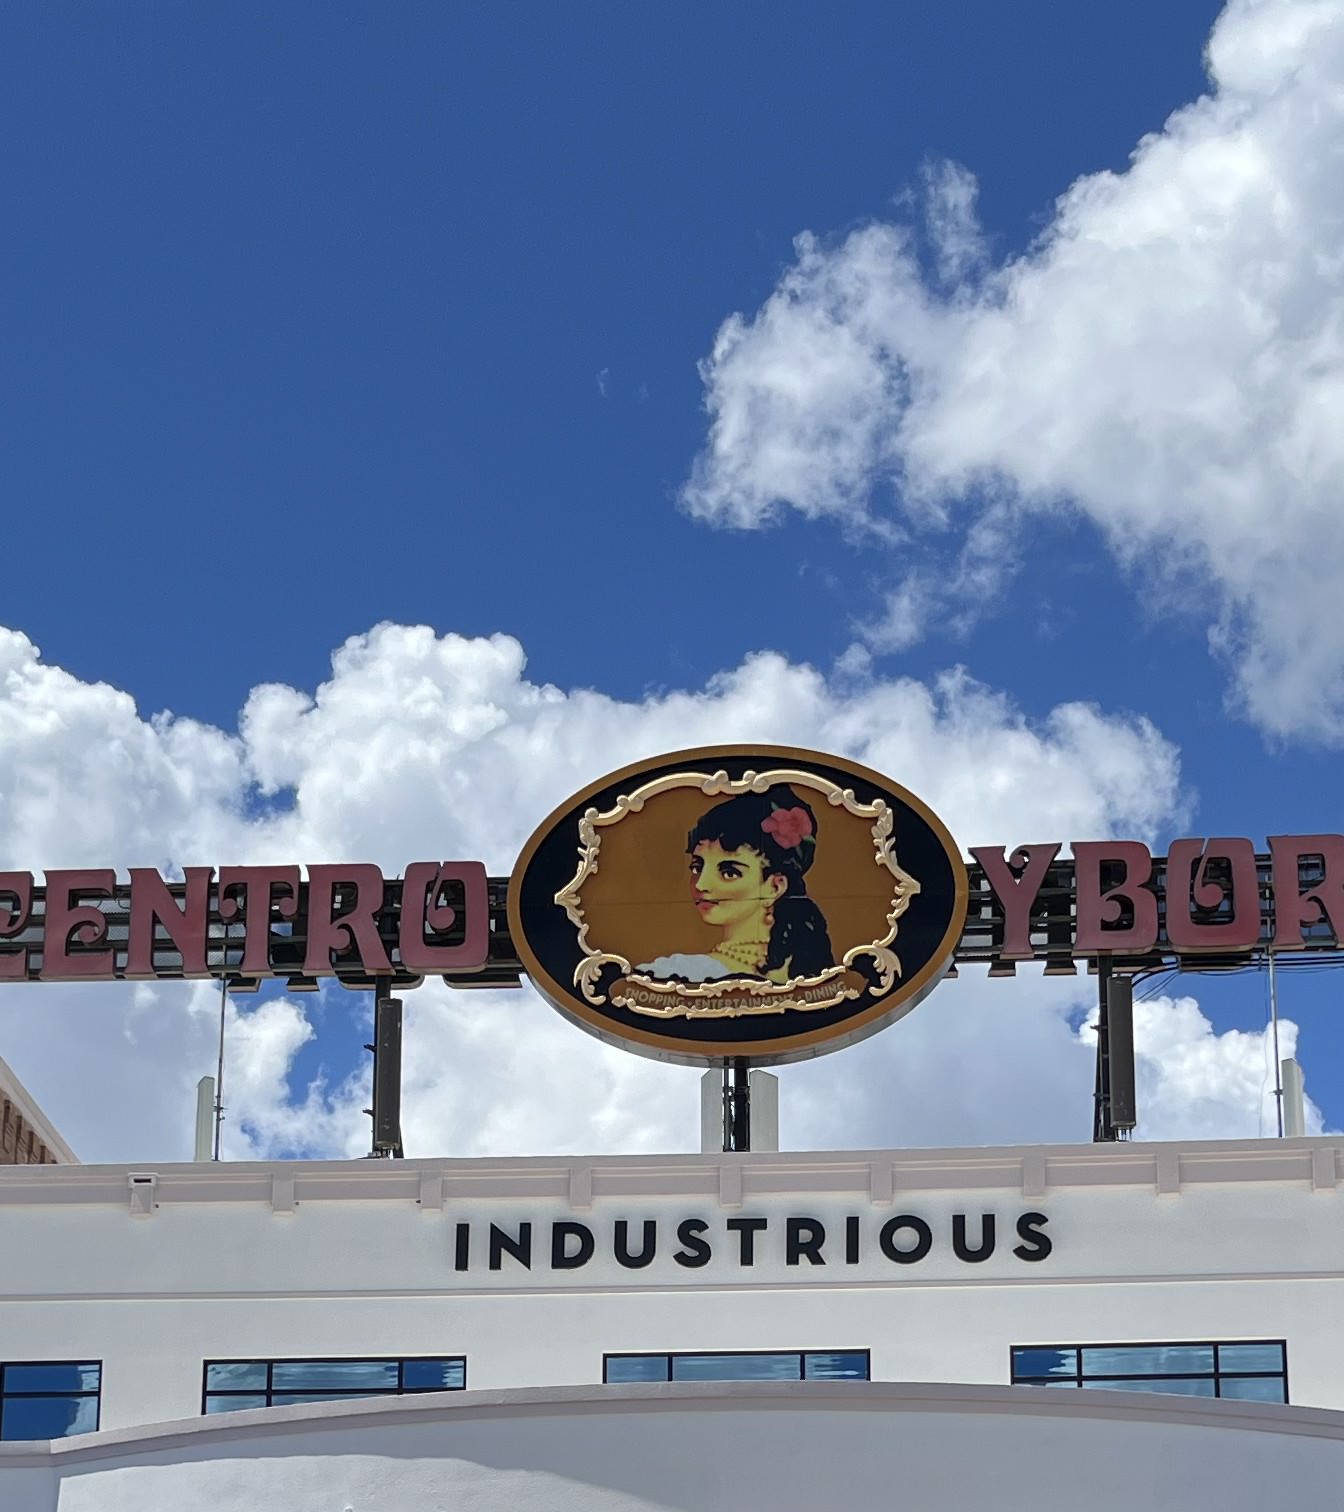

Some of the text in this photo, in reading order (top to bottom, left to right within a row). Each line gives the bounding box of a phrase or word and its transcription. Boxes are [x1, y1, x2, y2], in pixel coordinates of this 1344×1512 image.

[624, 981, 847, 1010] SHOPPING ENTERTAINMENT DINING
[455, 1212, 1053, 1271] INDUSTRIOUS
